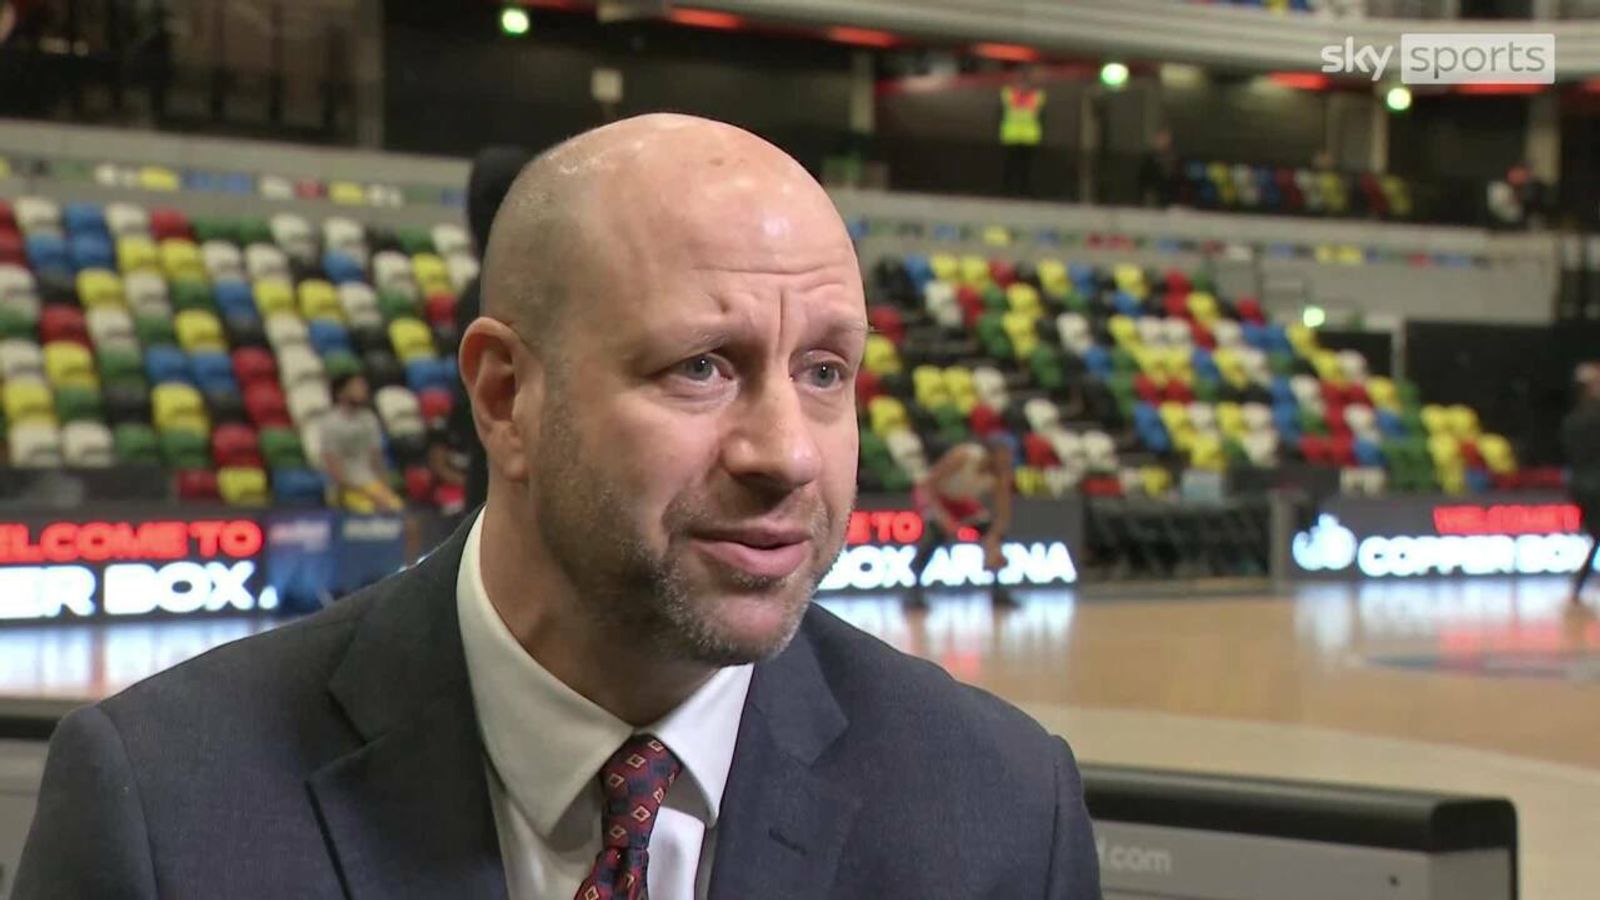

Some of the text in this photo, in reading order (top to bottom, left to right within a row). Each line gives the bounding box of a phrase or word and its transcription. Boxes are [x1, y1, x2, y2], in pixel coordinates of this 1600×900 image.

[189, 519, 263, 557] TO
[871, 510, 925, 544] TO
[1358, 535, 1515, 577] COPPER
